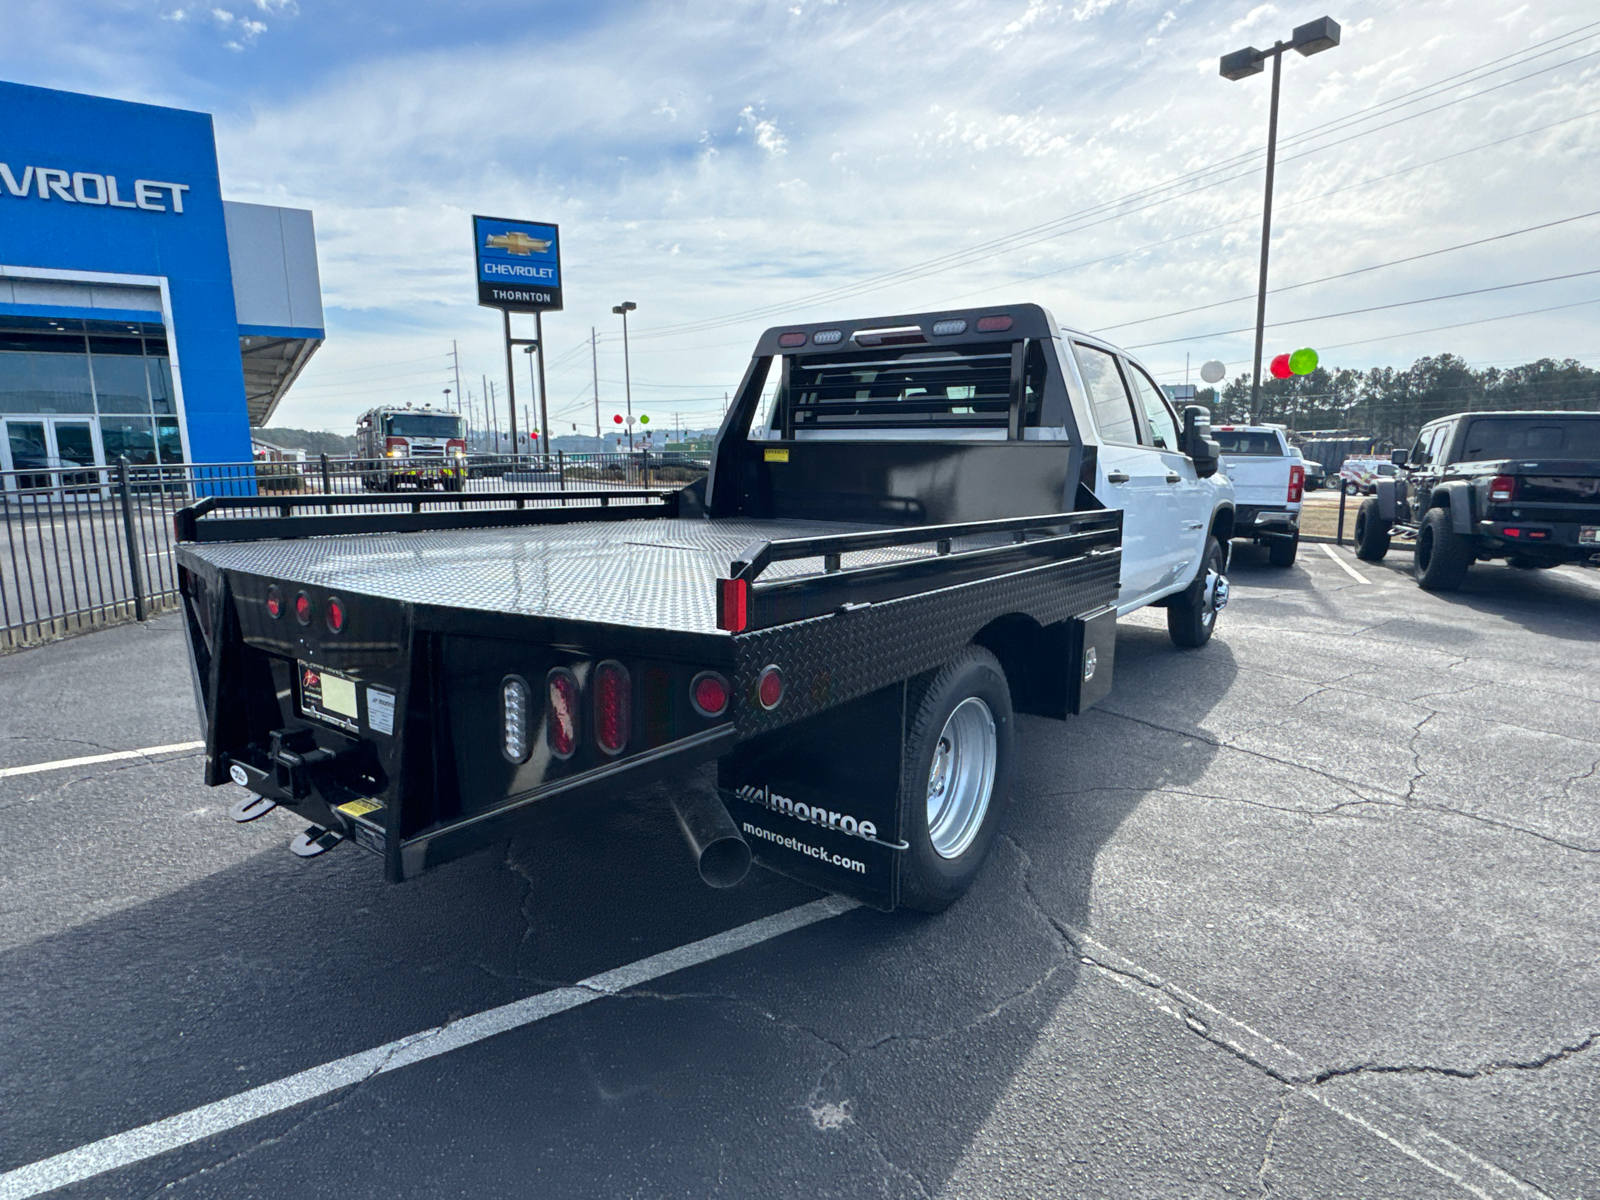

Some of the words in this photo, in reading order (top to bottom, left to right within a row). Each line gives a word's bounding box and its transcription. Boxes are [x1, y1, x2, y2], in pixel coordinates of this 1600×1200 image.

[0, 162, 190, 214] VROLET
[484, 263, 554, 278] CHEVROLET
[492, 289, 551, 302] THORNTON
[770, 793, 877, 840] monroe
[743, 822, 866, 874] monroetruck.com
